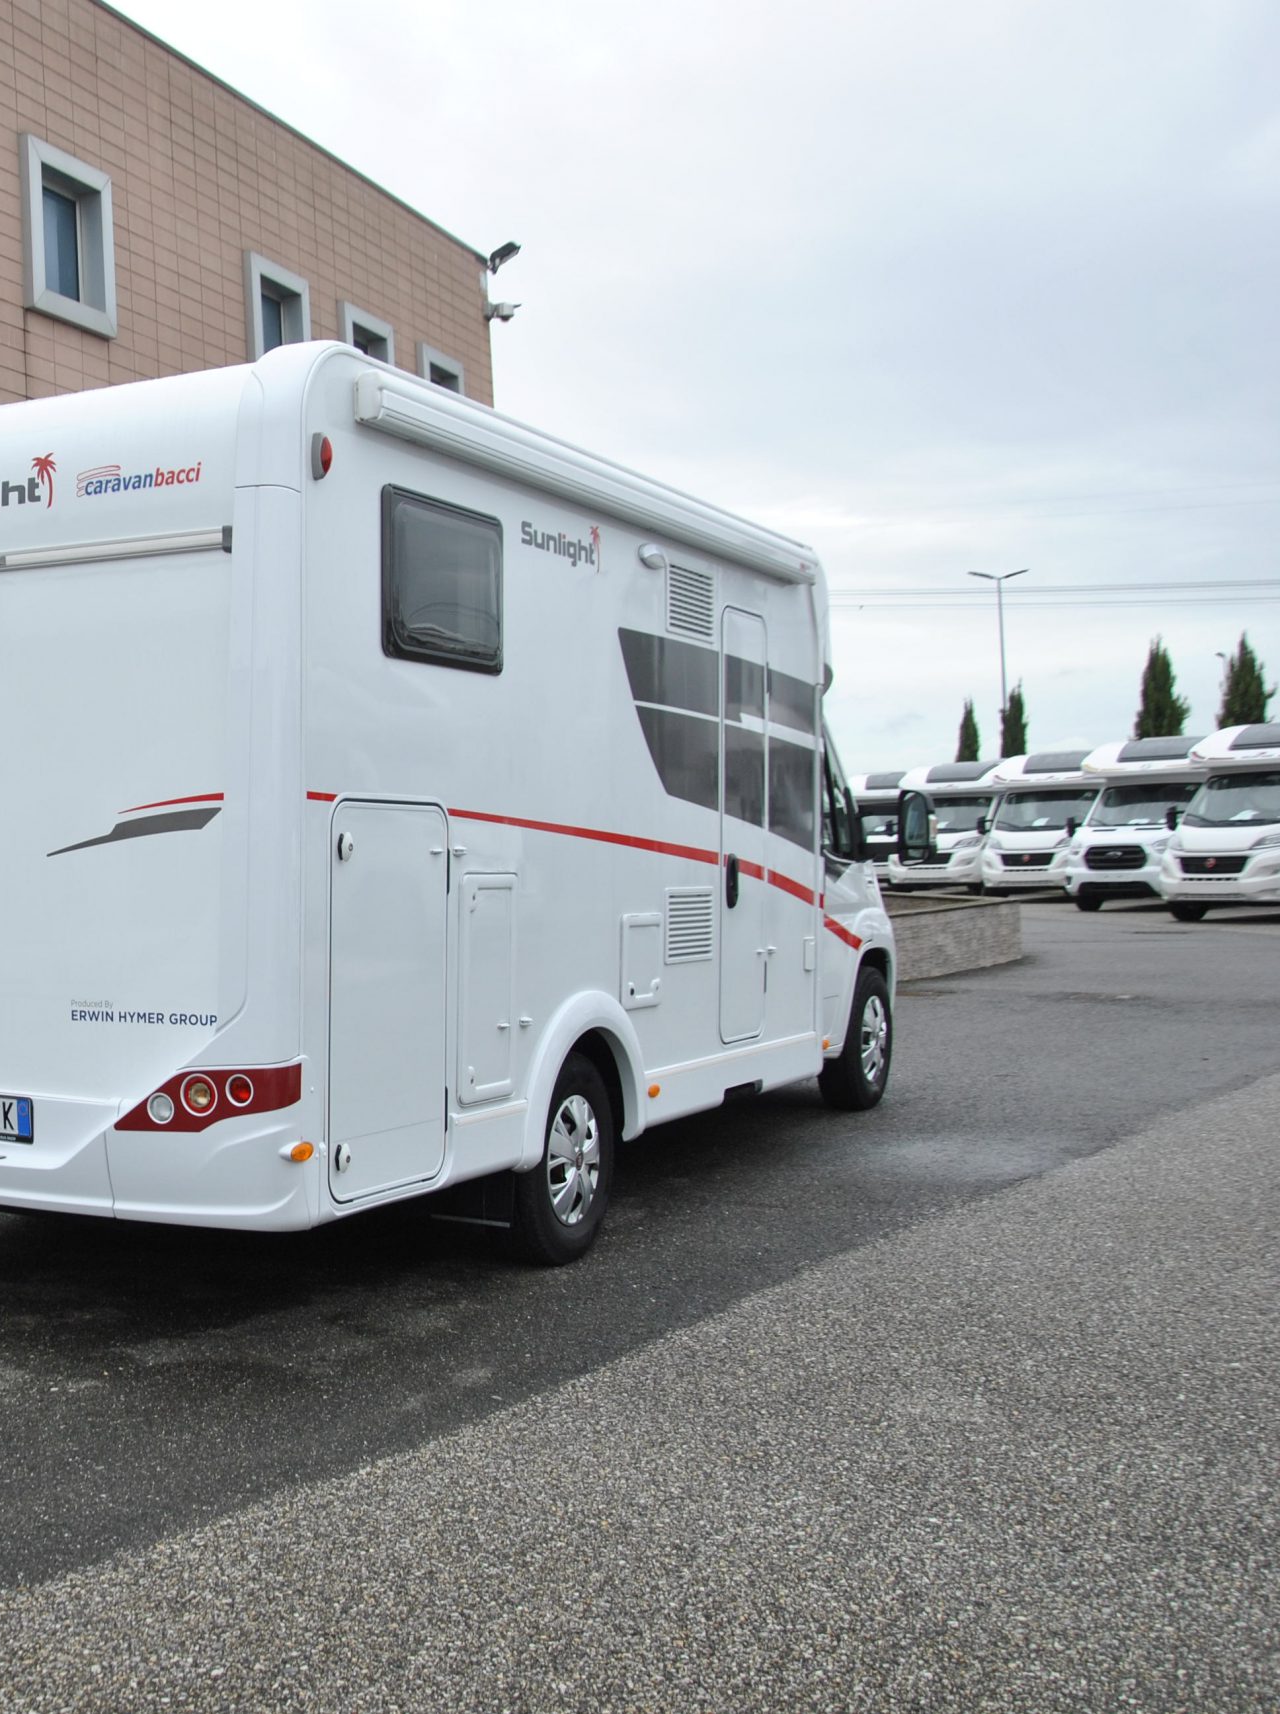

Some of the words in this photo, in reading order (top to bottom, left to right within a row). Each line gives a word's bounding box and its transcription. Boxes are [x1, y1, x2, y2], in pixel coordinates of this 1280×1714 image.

[84, 462, 202, 496] caravanbacci
[521, 520, 595, 567] Sunlight
[71, 999, 103, 1008] Produced
[104, 1000, 114, 1009] By
[71, 1009, 114, 1022] ERWIN
[119, 1011, 165, 1024] HYMER
[169, 1013, 218, 1026] GROUP
